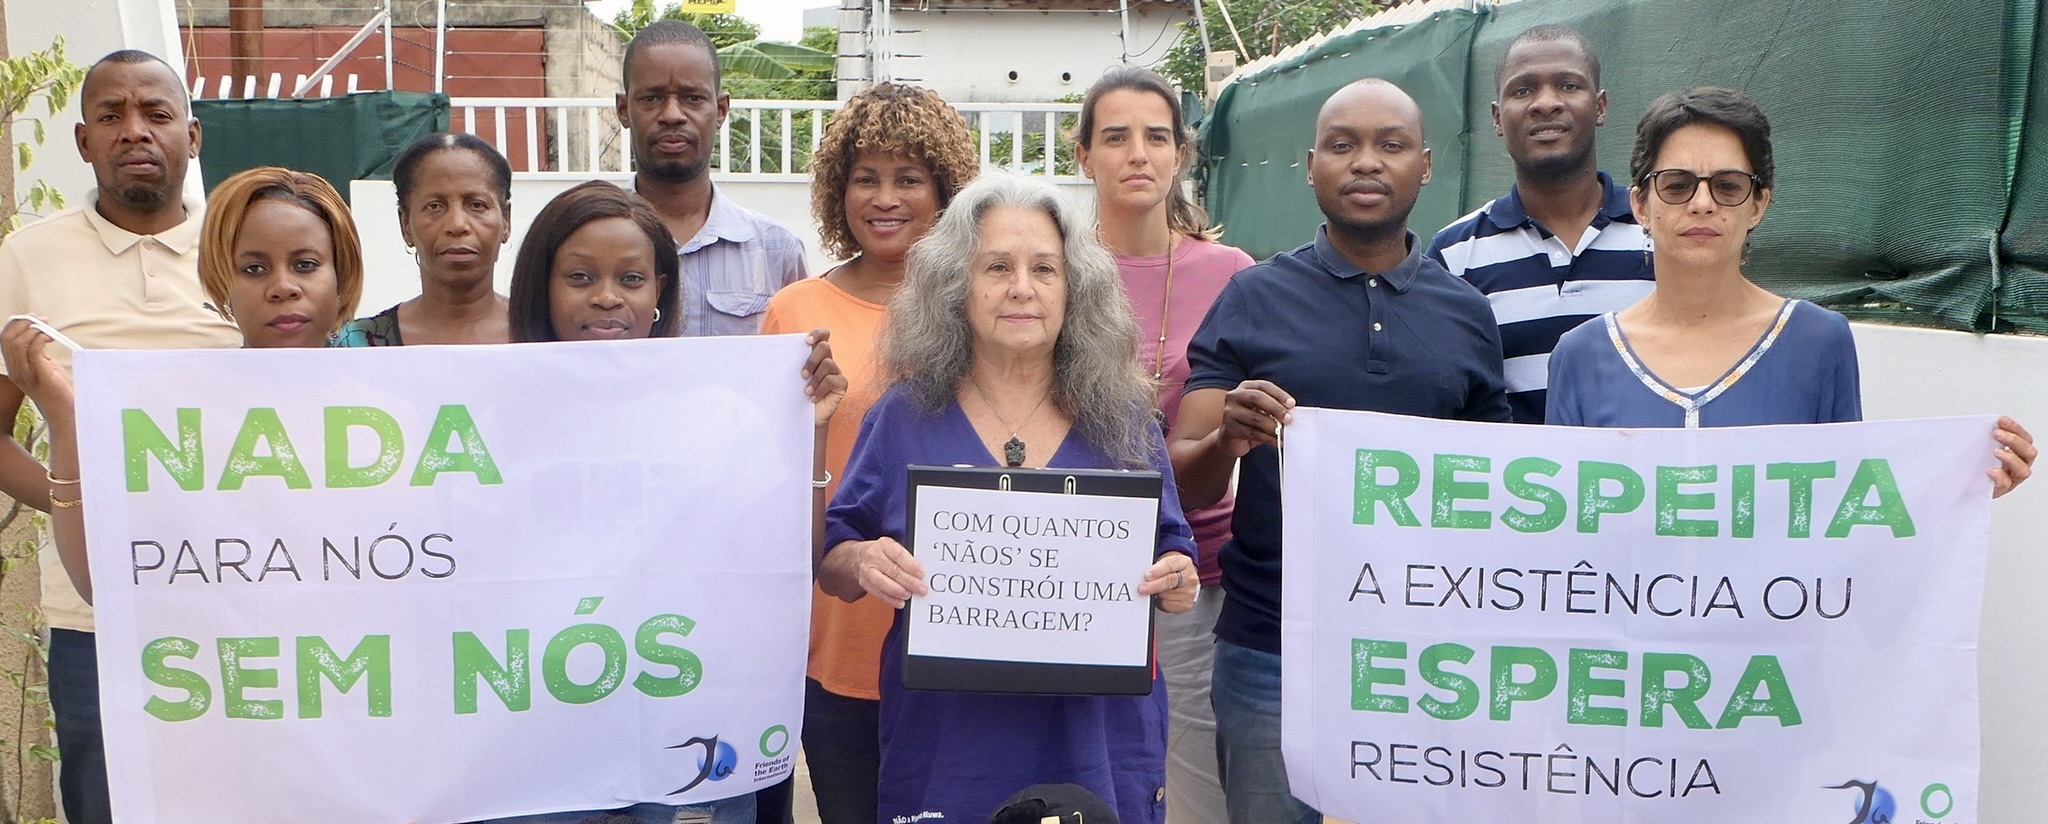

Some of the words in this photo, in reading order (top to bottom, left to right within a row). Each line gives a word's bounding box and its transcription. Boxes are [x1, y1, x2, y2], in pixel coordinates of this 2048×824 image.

[121, 404, 502, 493] NADA
[1352, 448, 1916, 539] RESPEITA
[131, 538, 303, 586] PARA
[322, 522, 457, 582] NÓS
[933, 510, 994, 534] COM
[1002, 514, 1131, 541] QUANTOS
[929, 572, 1064, 601] CONSTRÓI
[1073, 581, 1134, 602] UMA
[1029, 548, 1059, 569] SE
[927, 603, 1093, 632] BARRAGEM?
[1348, 562, 1387, 605] A
[1404, 559, 1745, 620] EXISTÊNCIA
[1762, 575, 1852, 621] OU
[141, 635, 392, 723] SEM
[451, 595, 704, 715] NÓS
[1351, 637, 1803, 730] ESPERA
[754, 769, 767, 777] the
[768, 763, 789, 774] Earth
[755, 758, 782, 770] Friends
[782, 755, 790, 763] of
[1350, 742, 1721, 799] RESISTÊNCIA
